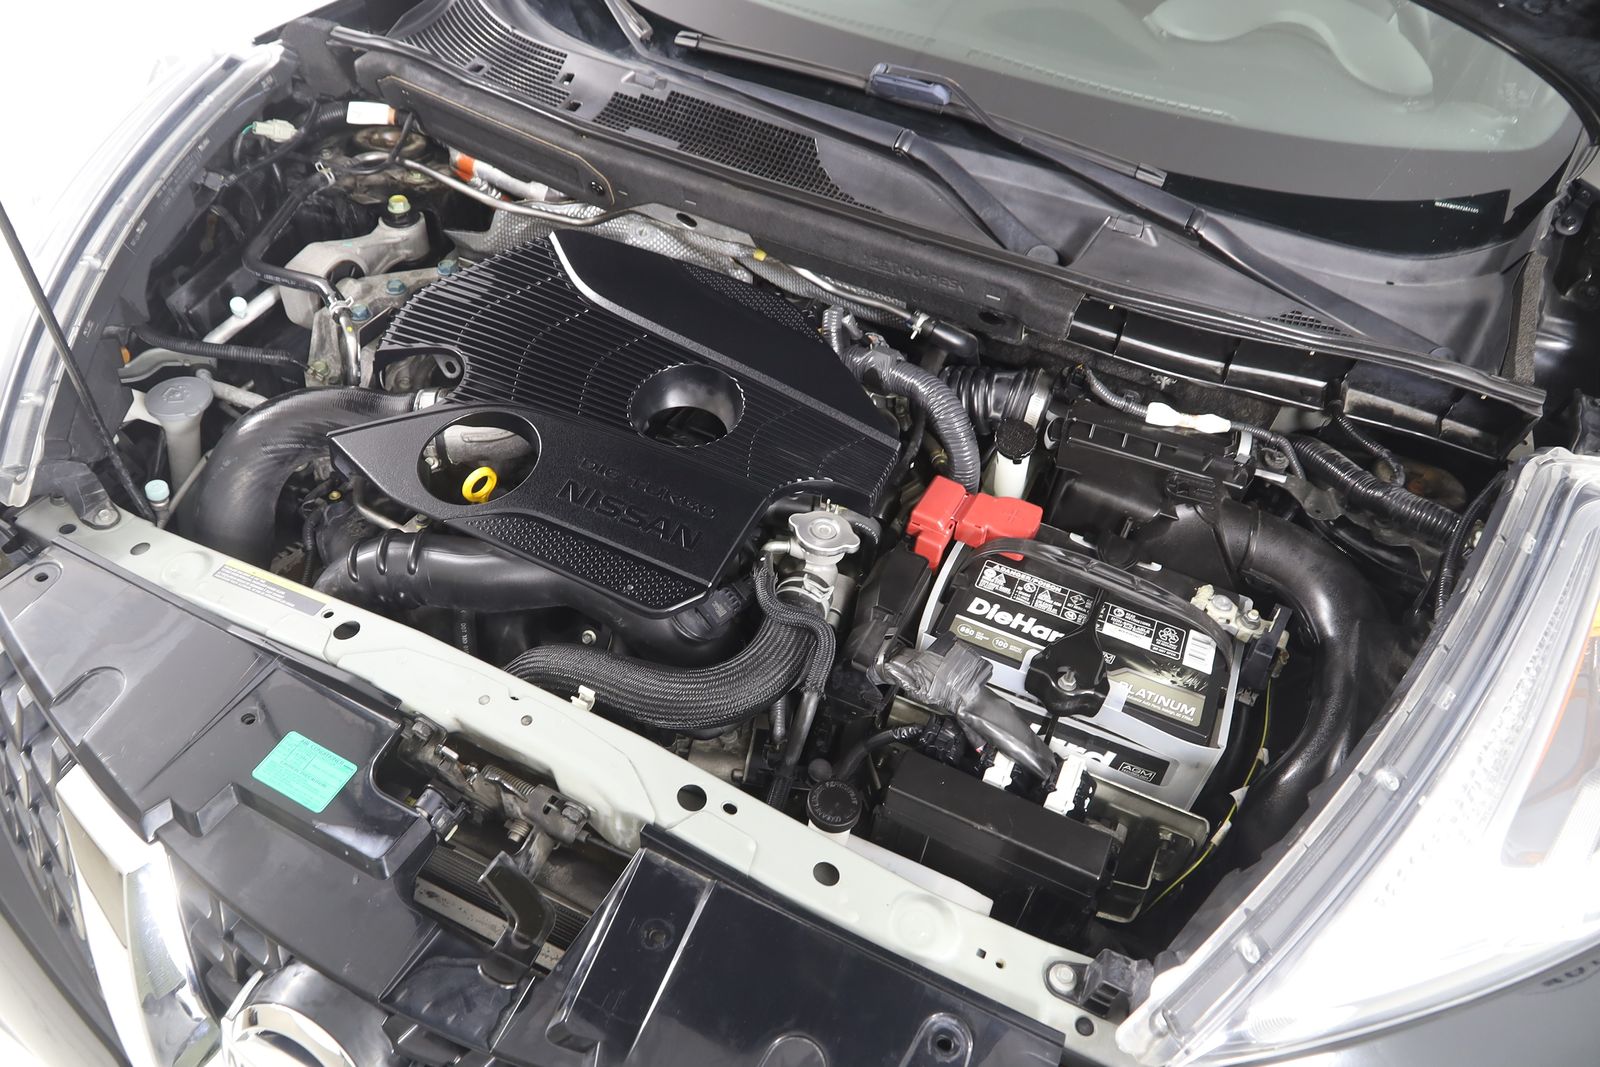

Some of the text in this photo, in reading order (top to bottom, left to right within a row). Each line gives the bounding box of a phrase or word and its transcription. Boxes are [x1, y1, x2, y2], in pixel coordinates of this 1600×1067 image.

[554, 478, 704, 553] NISSAN
[966, 596, 1066, 643] DieHar
[995, 639, 1009, 649] 100
[1123, 765, 1153, 778] AGM
